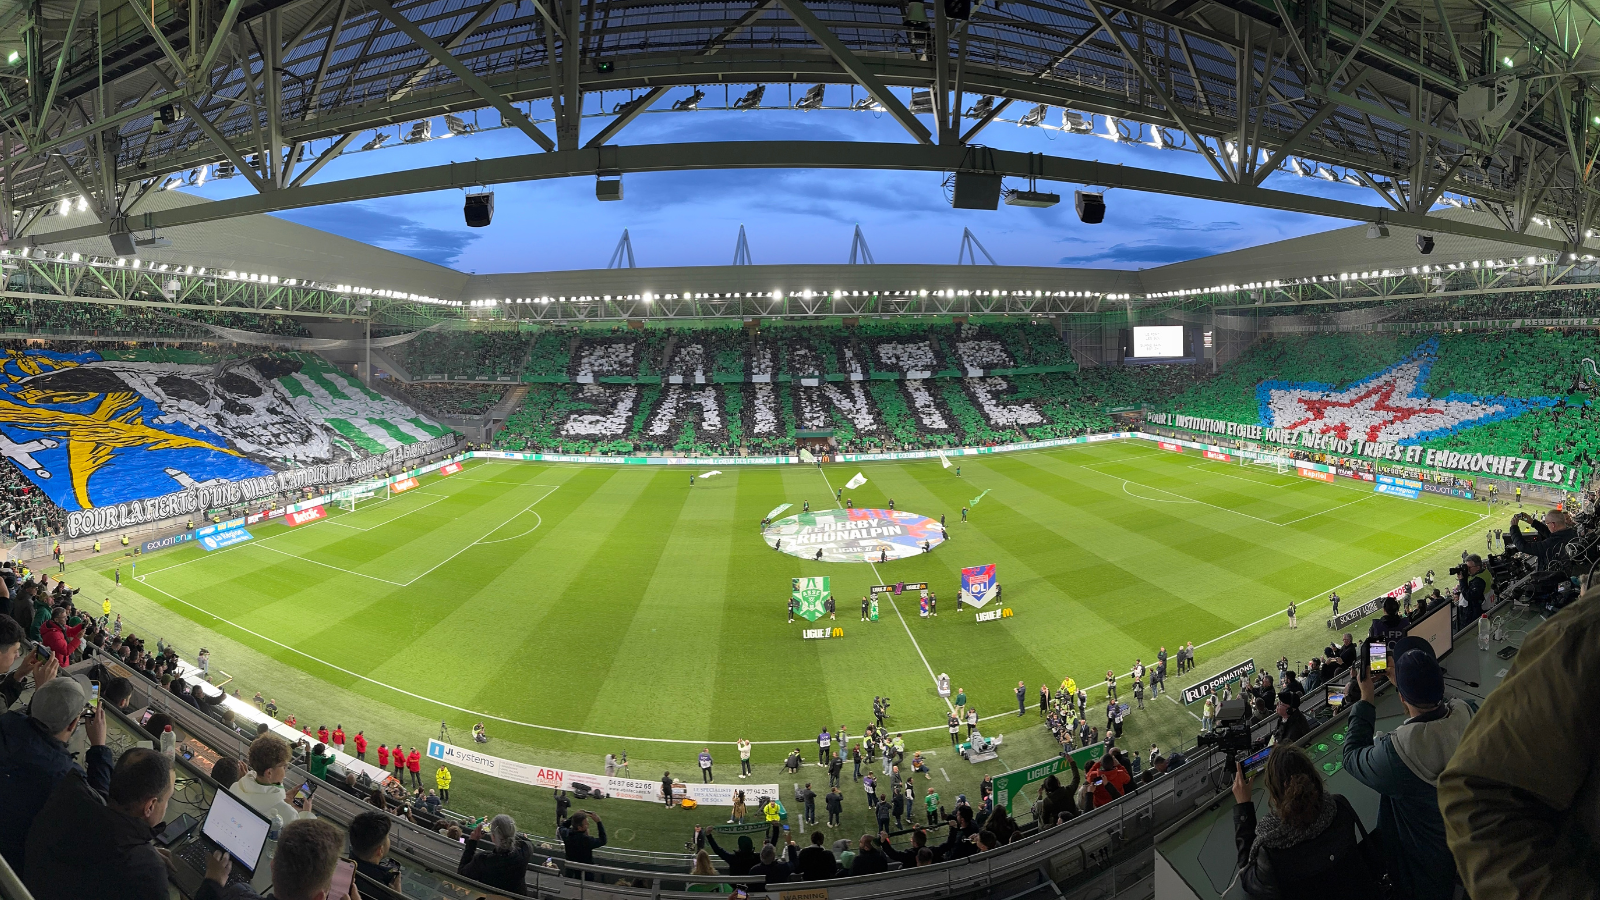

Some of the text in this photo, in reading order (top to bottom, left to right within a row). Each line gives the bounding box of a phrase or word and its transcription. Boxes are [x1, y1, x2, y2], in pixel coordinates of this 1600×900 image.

[1354, 323, 1372, 331] CLUB
[1460, 319, 1517, 330] MAILLOT
[1525, 318, 1588, 326] RESPECTER
[1147, 412, 1167, 425] POUR
[1265, 428, 1300, 446] JOUEZ
[1302, 432, 1328, 449] AVEC
[1330, 436, 1353, 453] VOS
[1358, 440, 1402, 461] TRIPES
[1406, 445, 1423, 463] ET
[1426, 449, 1529, 478] EMBROCHEZ
[1533, 460, 1564, 482] LES
[68, 505, 119, 538] POUR
[119, 501, 143, 526] LA
[144, 482, 197, 520] FIERTÉ
[198, 482, 241, 510] D'UNE
[293, 508, 320, 524] Betclic
[823, 518, 879, 532] DERBY
[971, 583, 986, 593] OL
[975, 610, 996, 622] LIGUE
[1340, 607, 1362, 624] SOCIETY
[803, 629, 825, 639] LIGUE
[1209, 662, 1254, 689] FORMATIONS
[445, 747, 455, 757] JL
[456, 750, 495, 768] systems
[537, 768, 563, 782] ABN
[1027, 766, 1051, 781] LIGUE
